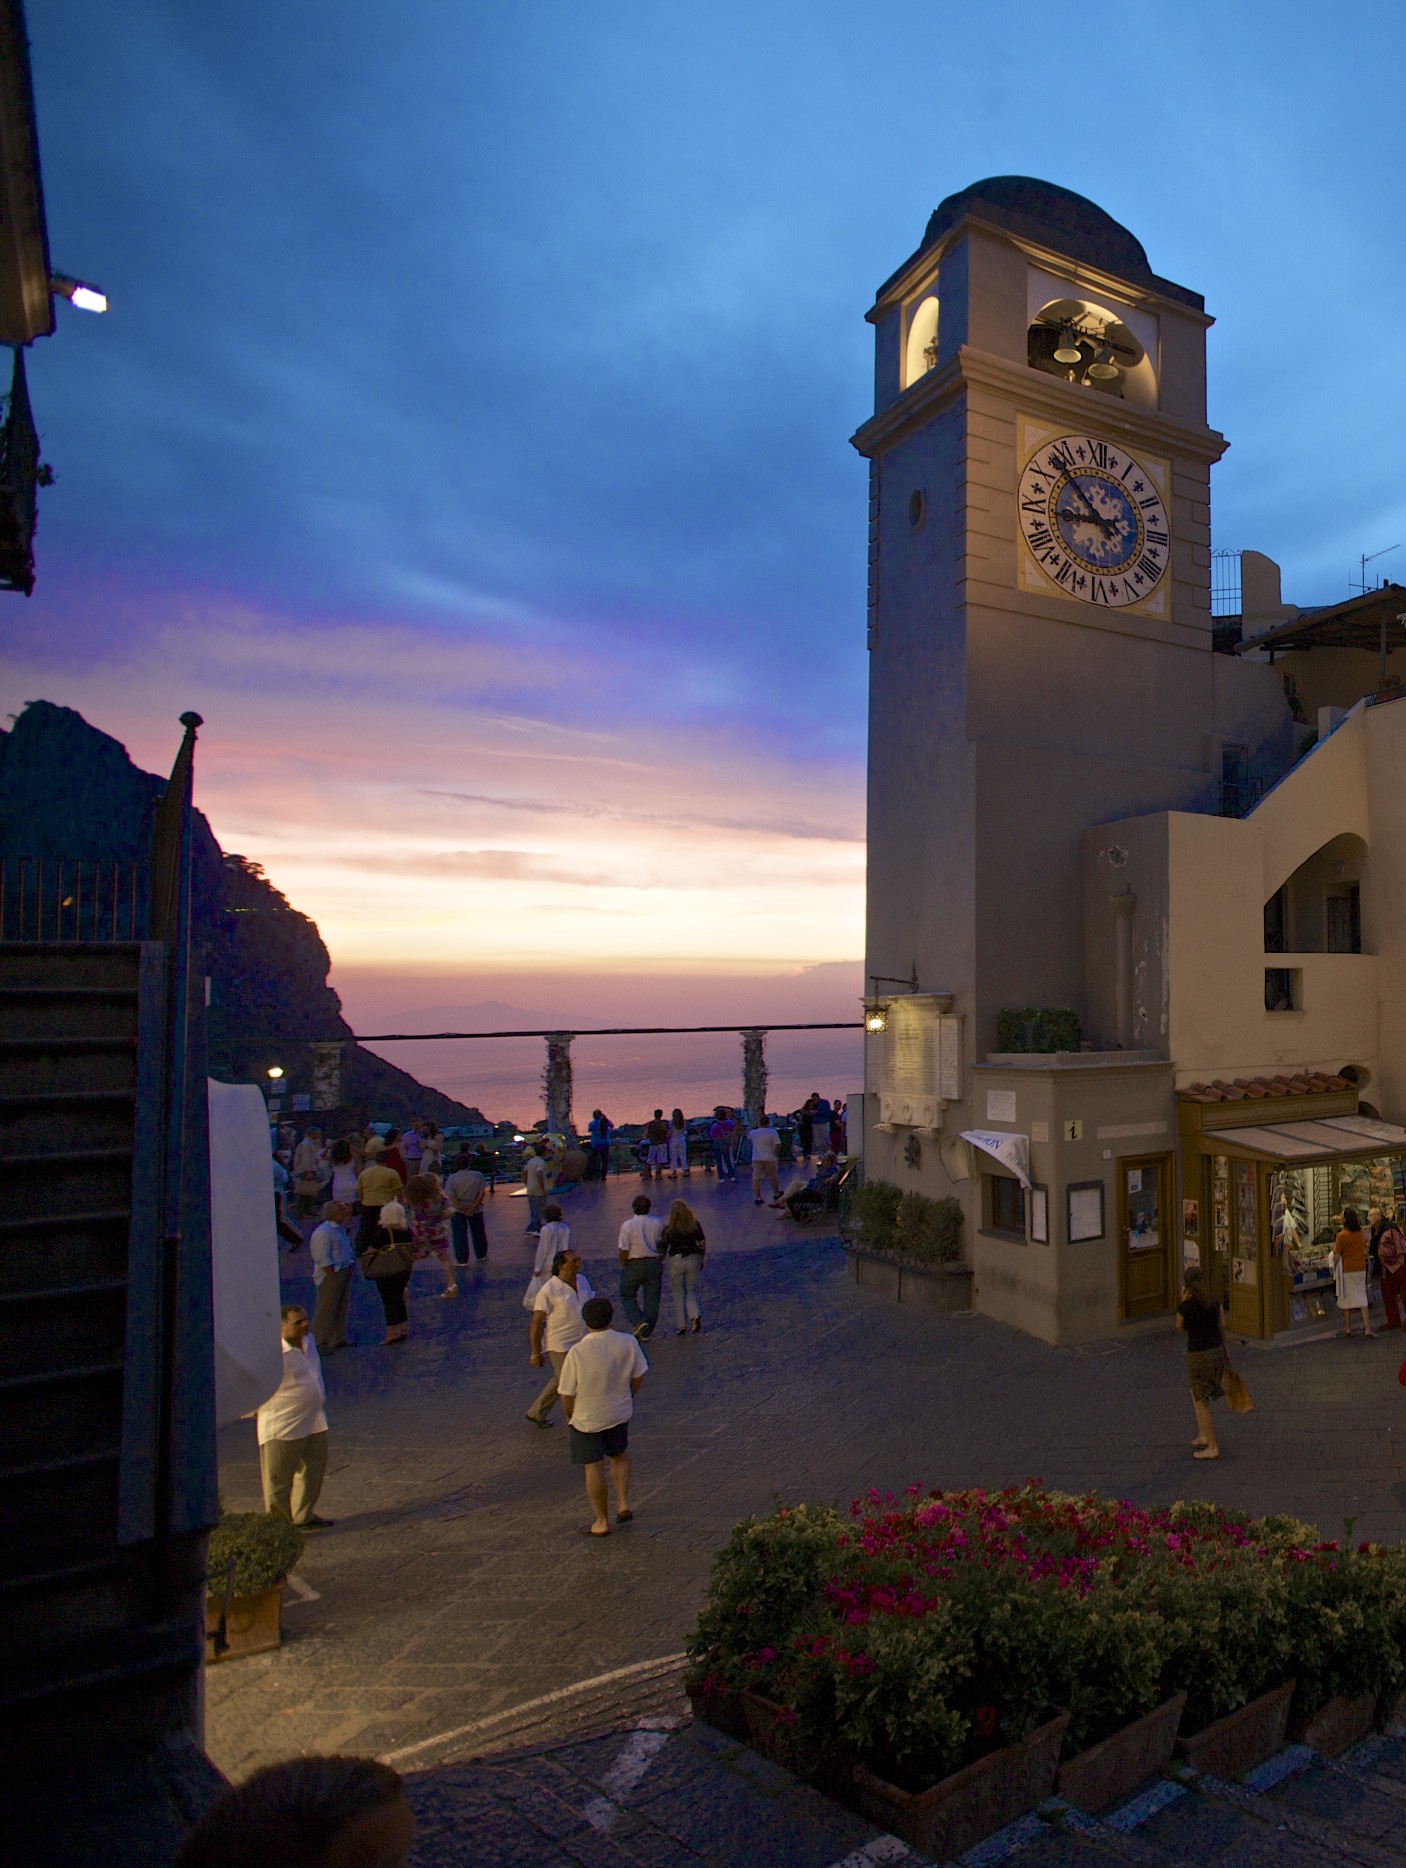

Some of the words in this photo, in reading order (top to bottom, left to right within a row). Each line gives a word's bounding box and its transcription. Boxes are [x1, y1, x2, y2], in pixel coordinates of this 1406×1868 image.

[1086, 439, 1108, 469] XII
[1028, 460, 1056, 487] X
[1120, 462, 1135, 481] I
[1021, 493, 1047, 515] IX
[1139, 495, 1160, 510] II
[1028, 529, 1054, 564] VIII
[1146, 529, 1168, 547] III
[1054, 559, 1077, 593] VII
[1136, 554, 1162, 583] IIII
[1091, 576, 1110, 604] VI
[1123, 576, 1140, 602] V
